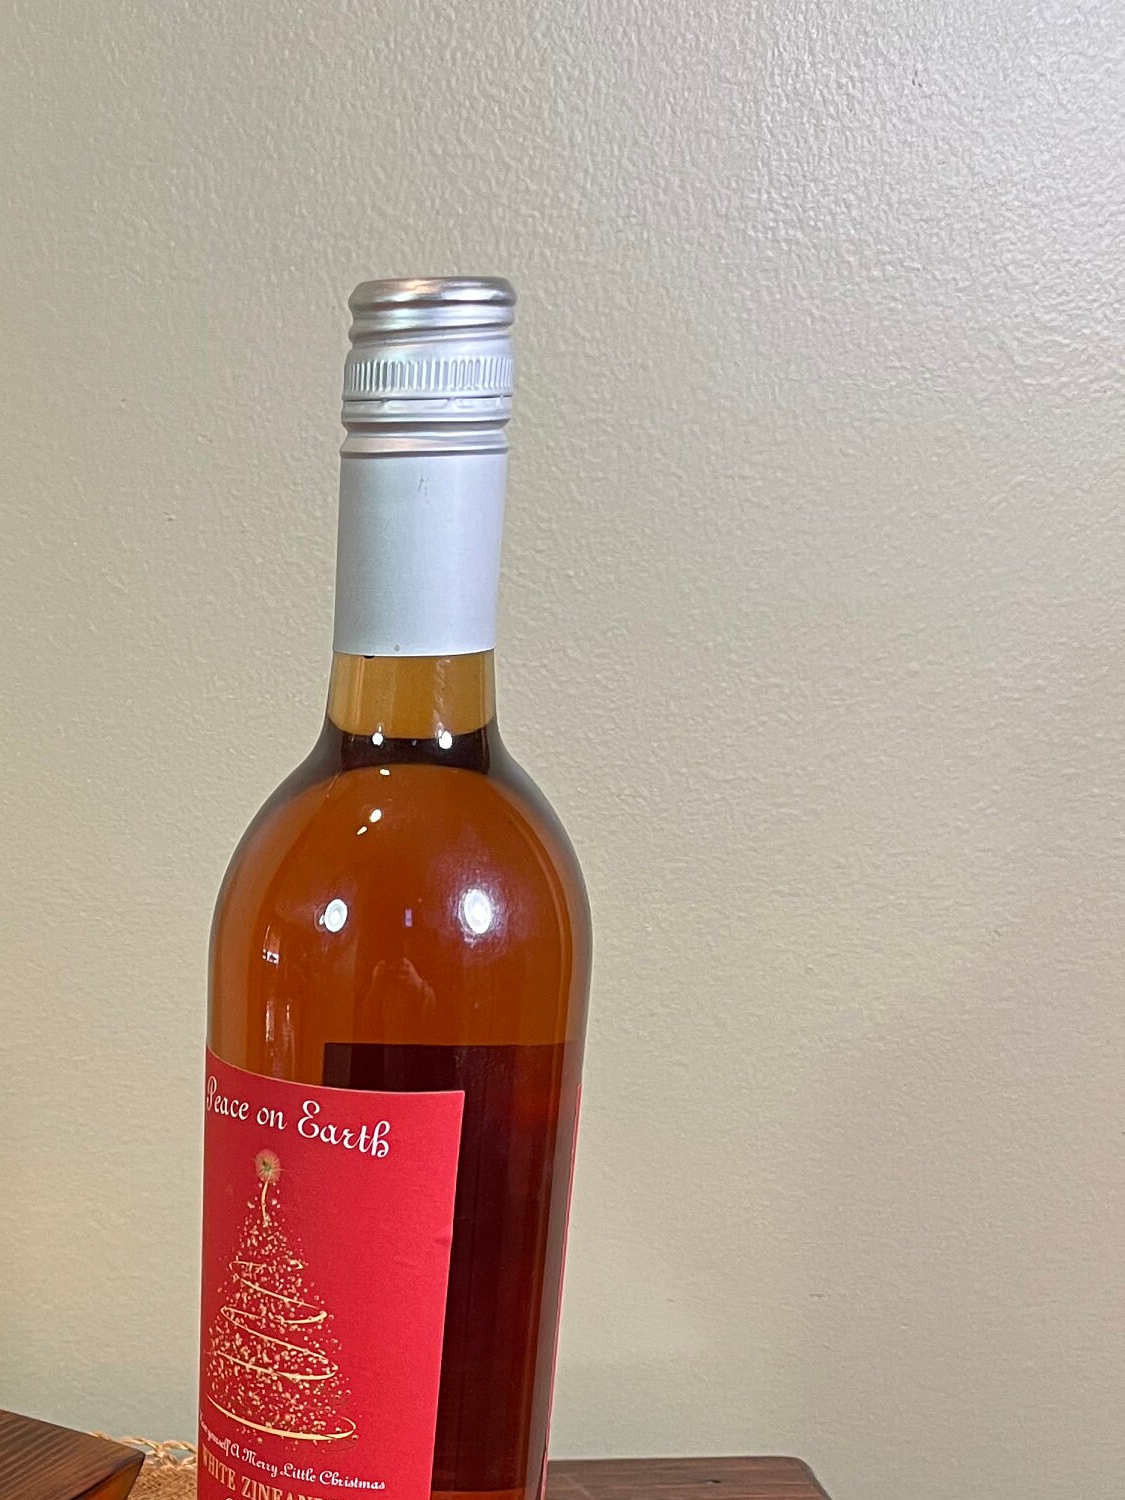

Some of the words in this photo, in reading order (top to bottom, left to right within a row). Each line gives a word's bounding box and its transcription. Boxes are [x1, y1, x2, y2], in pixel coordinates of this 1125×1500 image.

[206, 1075, 249, 1121] Peace
[256, 1105, 288, 1131] on
[297, 1100, 391, 1158] Earth
[242, 1447, 278, 1478] Merry
[280, 1462, 316, 1483] Little
[319, 1470, 386, 1490] Christmas
